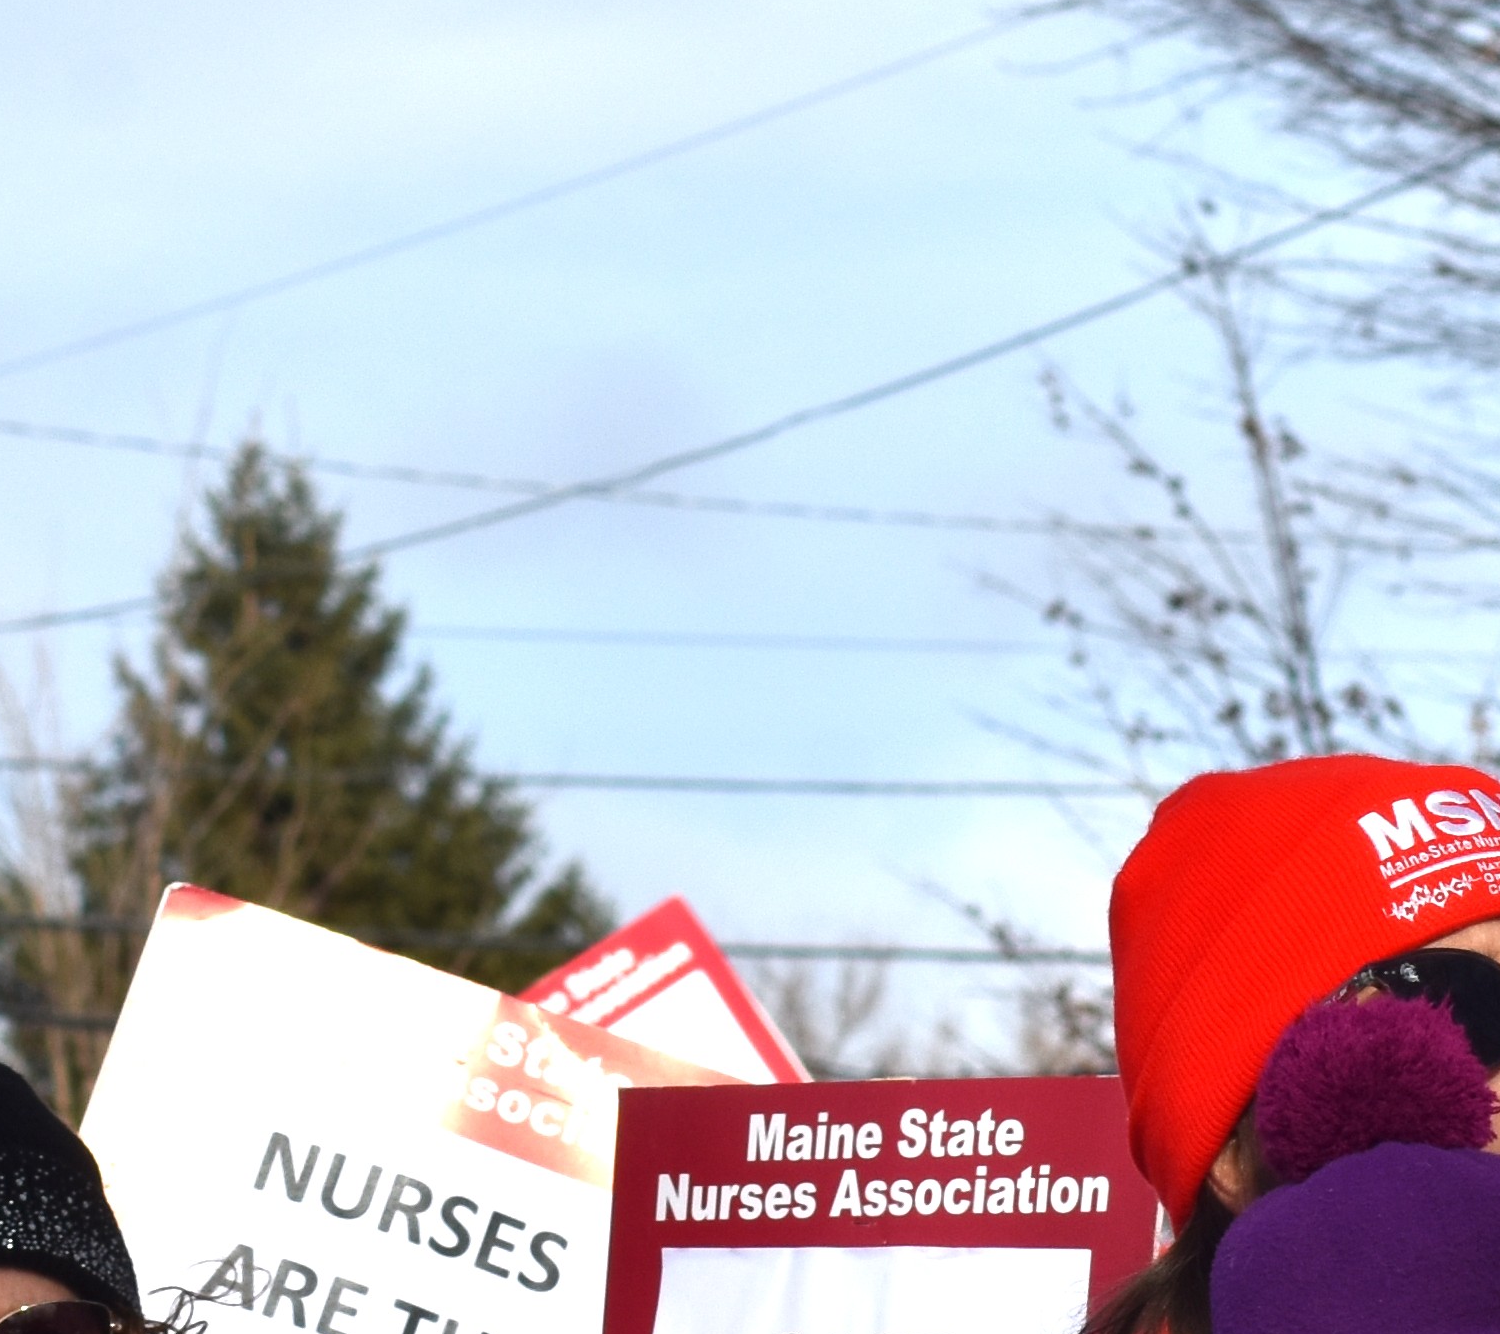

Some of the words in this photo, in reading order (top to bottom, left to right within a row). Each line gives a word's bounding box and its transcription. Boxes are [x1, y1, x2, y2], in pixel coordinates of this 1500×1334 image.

[746, 1112, 883, 1162] Maine
[897, 1108, 1025, 1157] State
[253, 1131, 568, 1293] NURSES
[655, 1173, 817, 1221] Nurses
[830, 1164, 1110, 1218] Association
